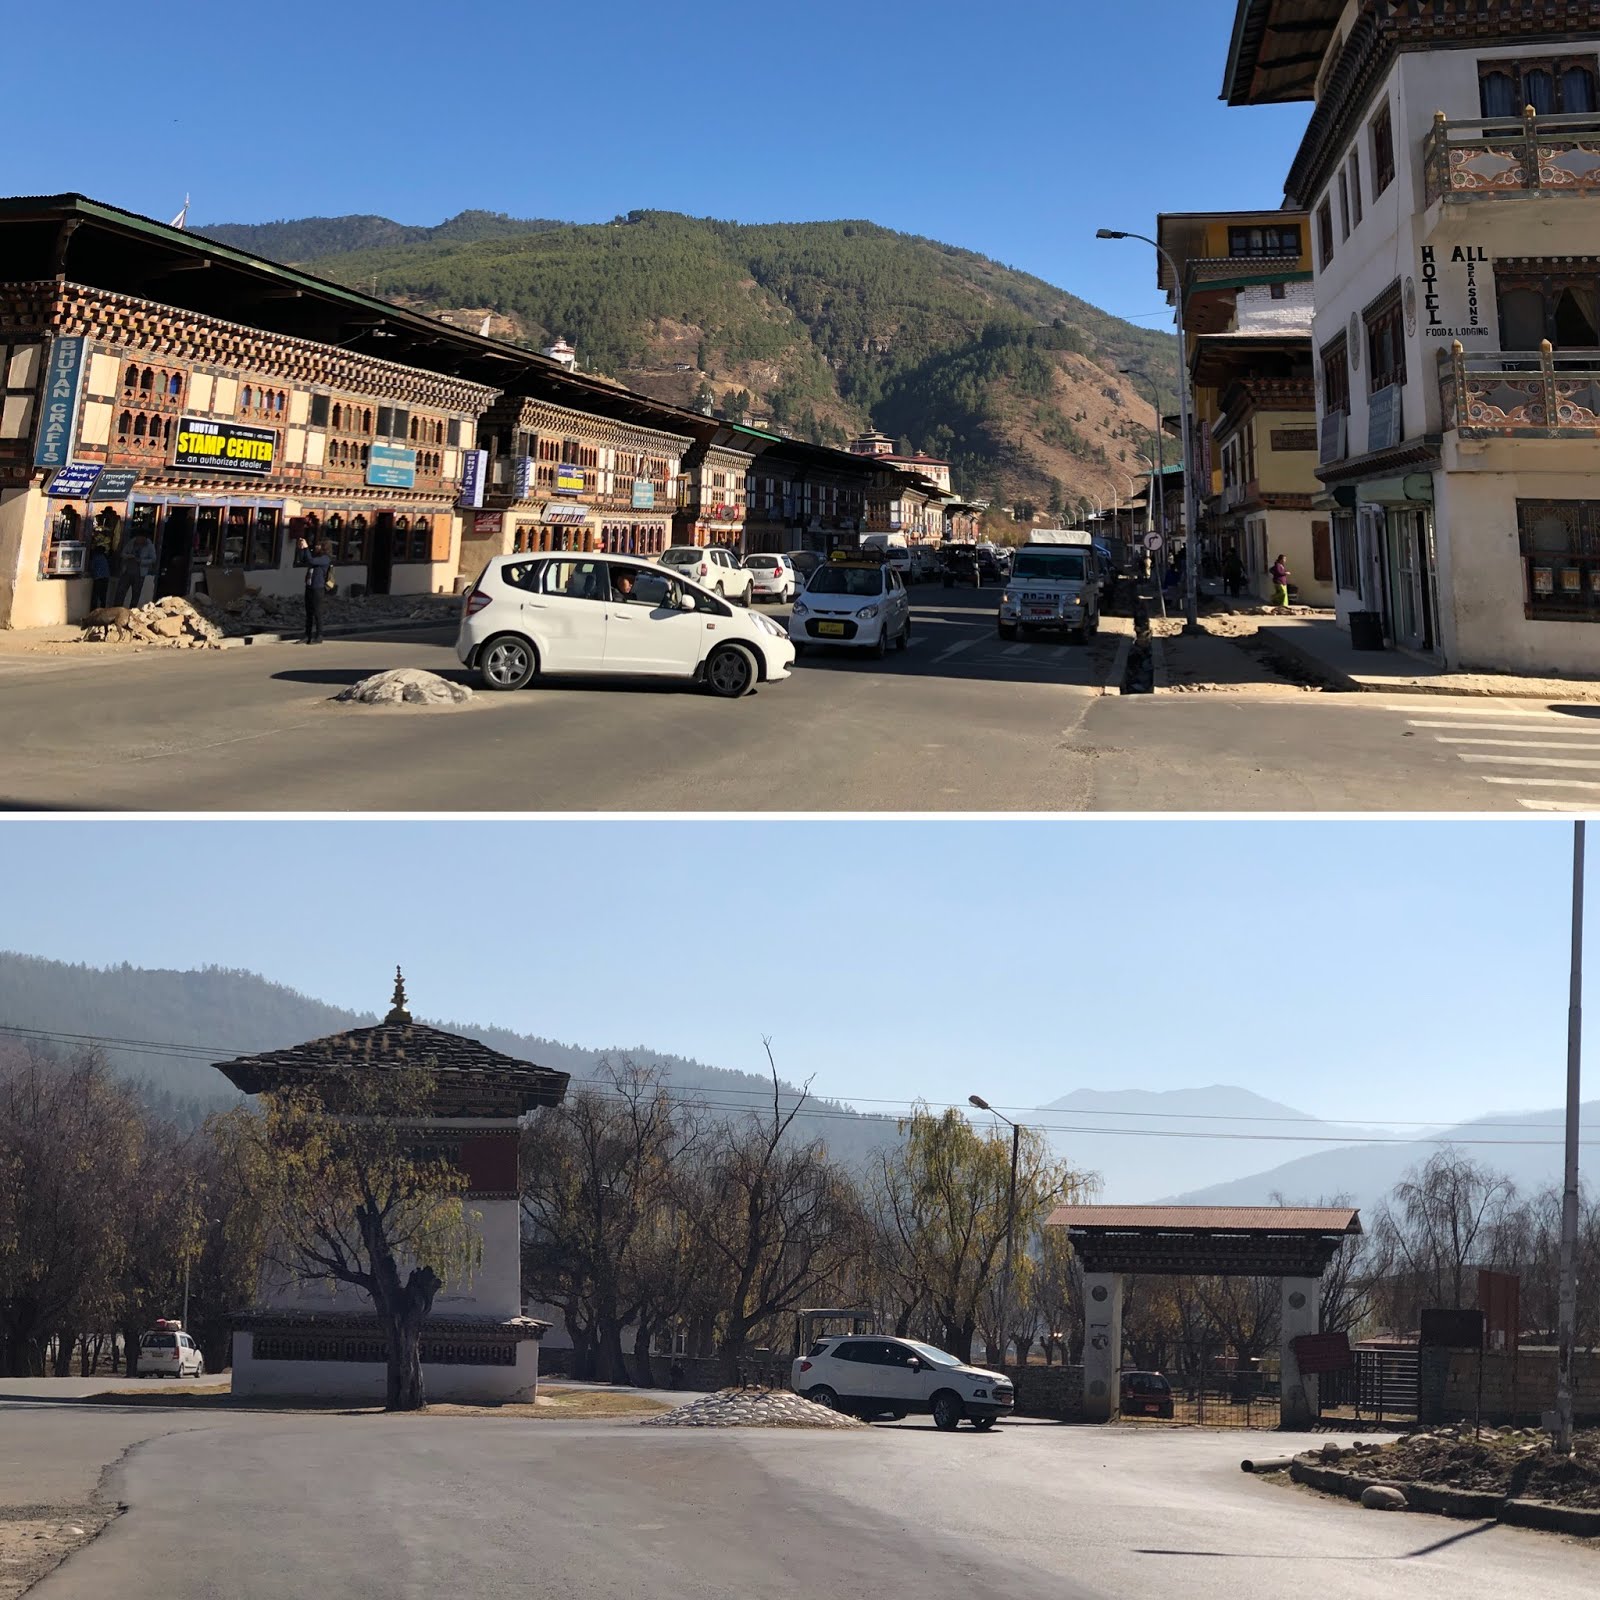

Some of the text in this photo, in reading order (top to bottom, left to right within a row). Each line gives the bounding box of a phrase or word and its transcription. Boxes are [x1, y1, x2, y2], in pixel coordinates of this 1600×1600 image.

[1451, 245, 1488, 262] ALL
[1420, 245, 1442, 325] HOTEL
[1467, 263, 1478, 325] SEASONS
[1426, 327, 1489, 337] FOOD & LODGING
[43, 340, 76, 462] BHUTAN CRAFTS
[189, 422, 219, 435] BHUTAN
[178, 432, 226, 456] STAMP
[226, 438, 273, 461] CENTER
[199, 457, 238, 467] authorized
[240, 459, 263, 469] dealer
